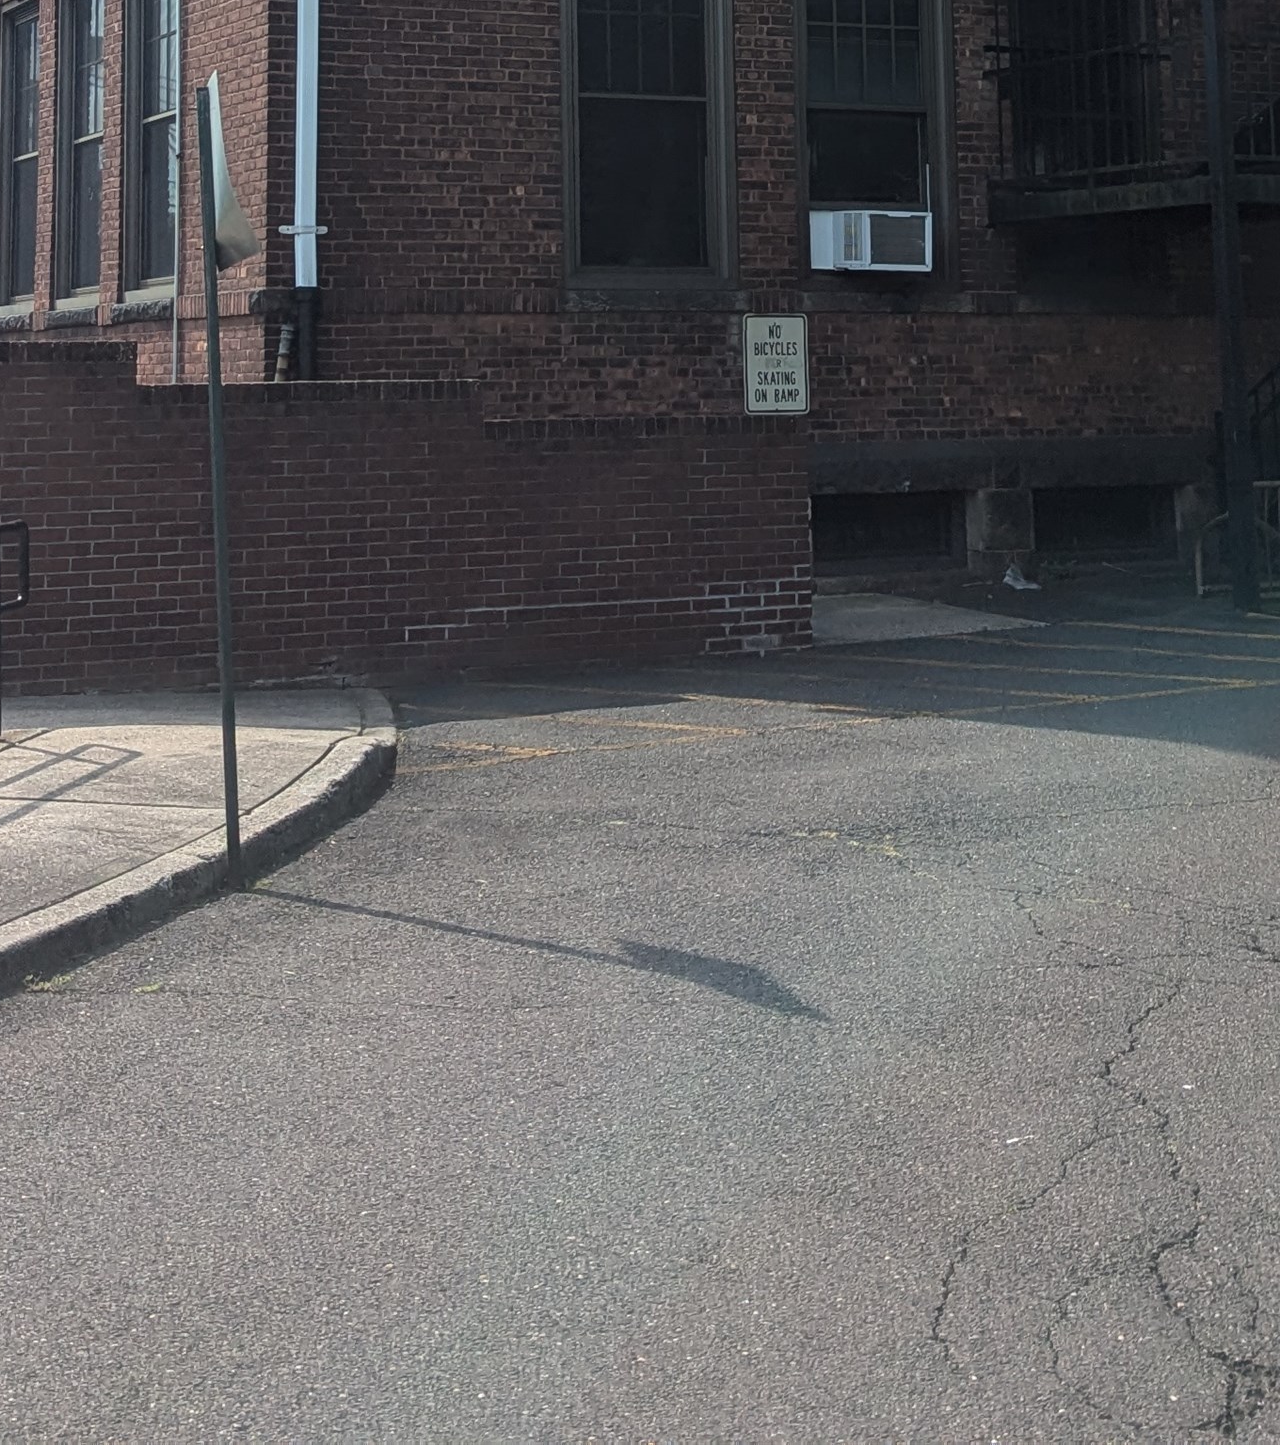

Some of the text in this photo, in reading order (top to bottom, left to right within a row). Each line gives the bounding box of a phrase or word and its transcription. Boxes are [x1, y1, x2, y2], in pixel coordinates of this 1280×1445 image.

[768, 324, 781, 339] NO
[754, 341, 798, 356] BICYCLES
[757, 371, 796, 386] SKATING
[754, 388, 768, 403] ON
